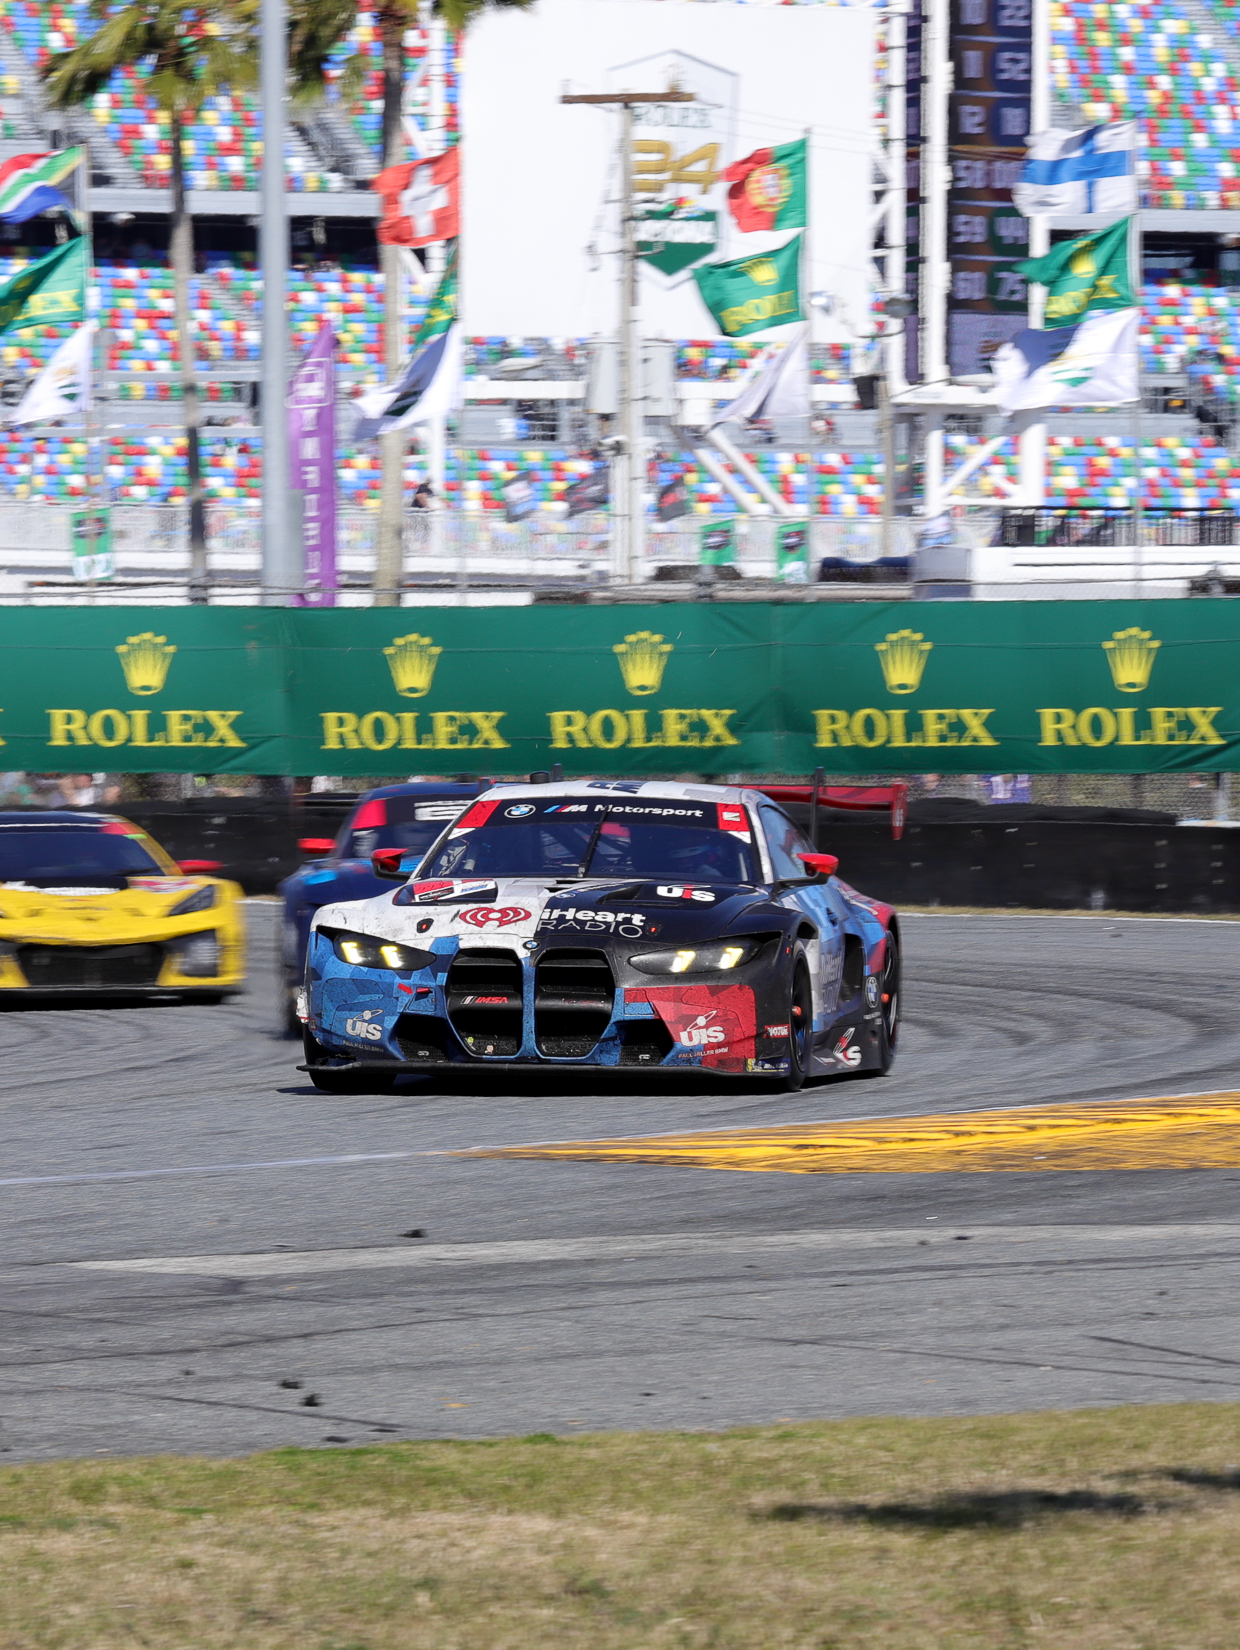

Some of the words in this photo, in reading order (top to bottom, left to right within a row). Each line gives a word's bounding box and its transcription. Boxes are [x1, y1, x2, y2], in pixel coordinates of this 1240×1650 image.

[47, 709, 247, 748] ROLEX
[321, 711, 510, 750] ROLEX
[548, 709, 739, 748] ROLEX
[813, 707, 1000, 748] ROLEX
[1036, 706, 1227, 747] ROLEX
[594, 804, 703, 818] Motorsport
[540, 908, 646, 926] iHeart
[536, 919, 643, 938] RADIO
[474, 996, 509, 1004] IMSA
[346, 1019, 383, 1041] UIS
[680, 1025, 725, 1047] UIS
